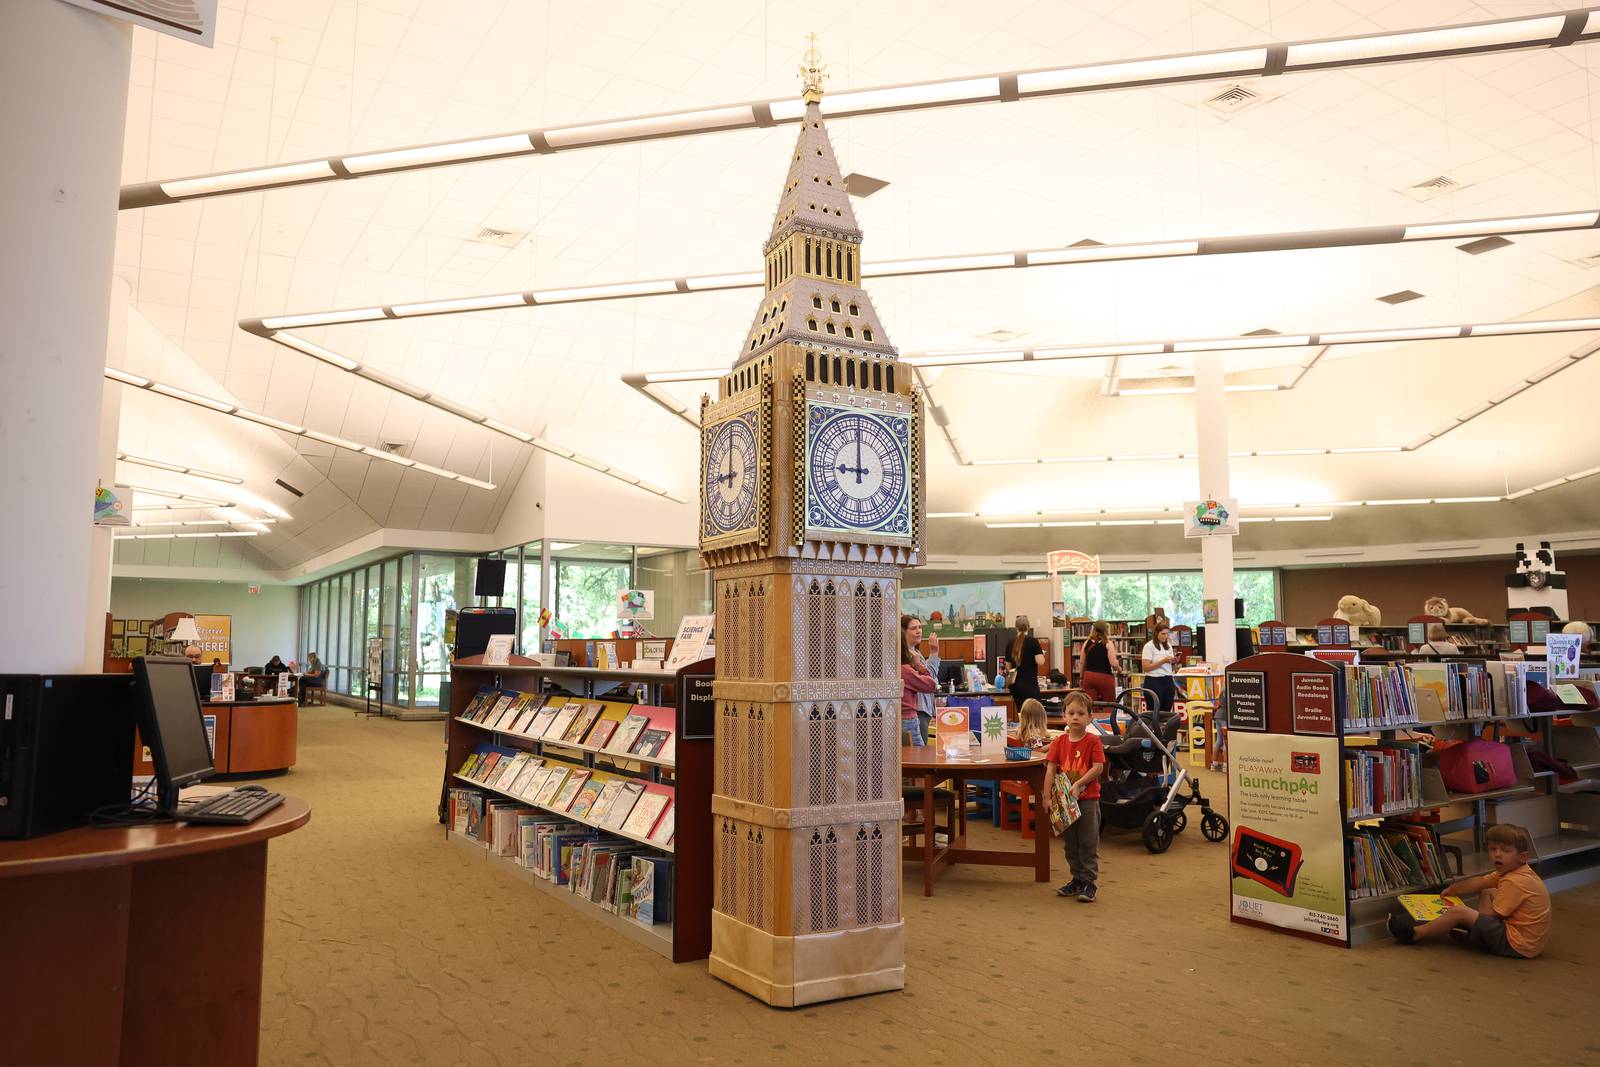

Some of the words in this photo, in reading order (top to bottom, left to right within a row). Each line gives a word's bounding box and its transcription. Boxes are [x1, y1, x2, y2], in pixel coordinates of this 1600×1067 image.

[1055, 554, 1096, 572] teens
[691, 694, 715, 702] Displa
[1190, 680, 1203, 698] A
[1174, 702, 1188, 721] B
[1239, 764, 1284, 775] PLAYAWAY
[1240, 774, 1318, 794] launchpad
